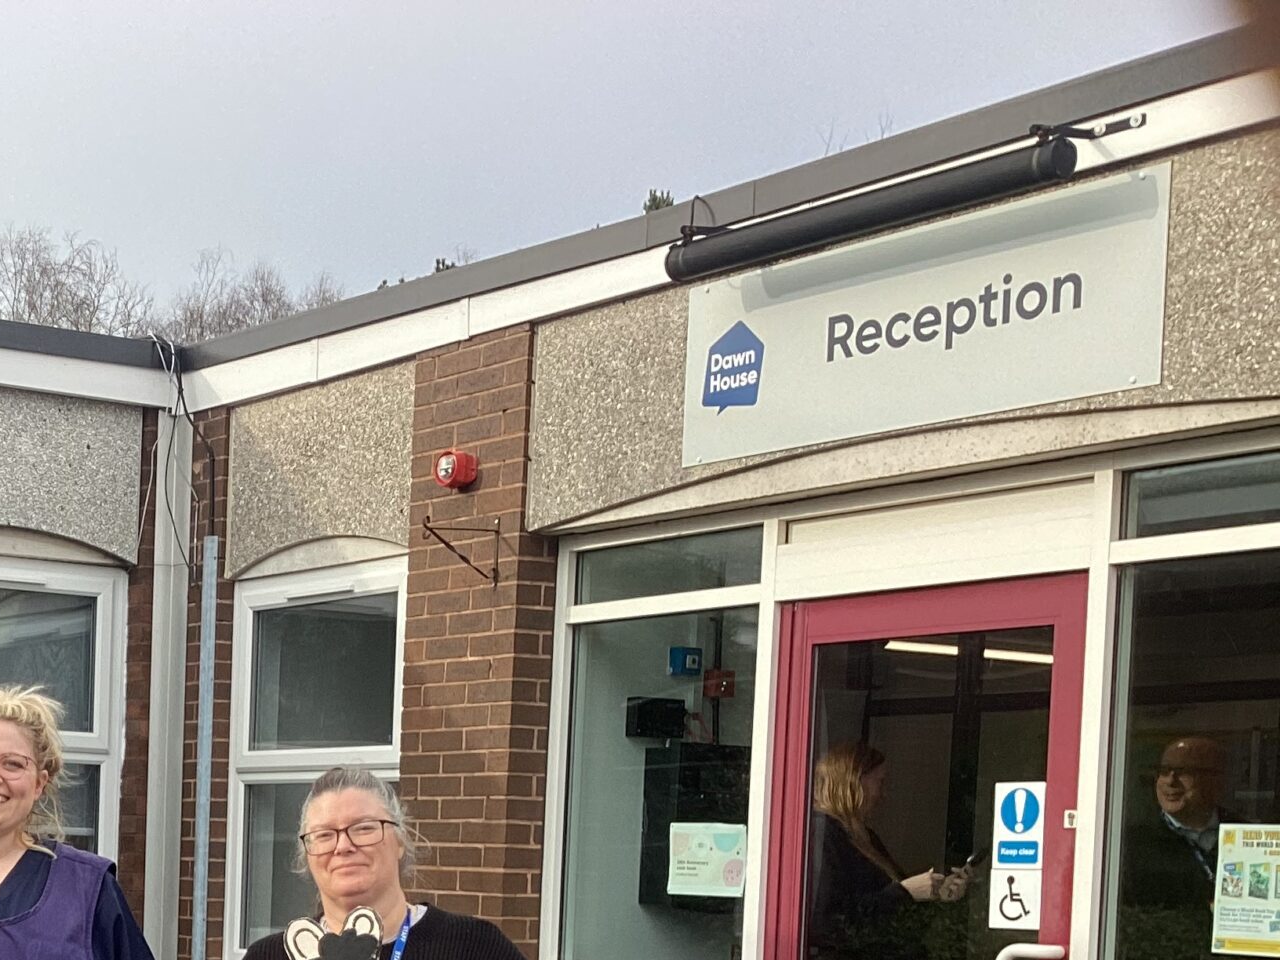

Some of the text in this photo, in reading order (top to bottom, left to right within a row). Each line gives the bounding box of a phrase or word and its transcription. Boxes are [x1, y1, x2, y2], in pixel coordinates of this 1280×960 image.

[826, 273, 1083, 363] Reception
[711, 349, 755, 373] Dawn
[709, 369, 758, 393] House
[1000, 847, 1036, 857] Keep clear
[401, 925, 409, 942] STAFF
